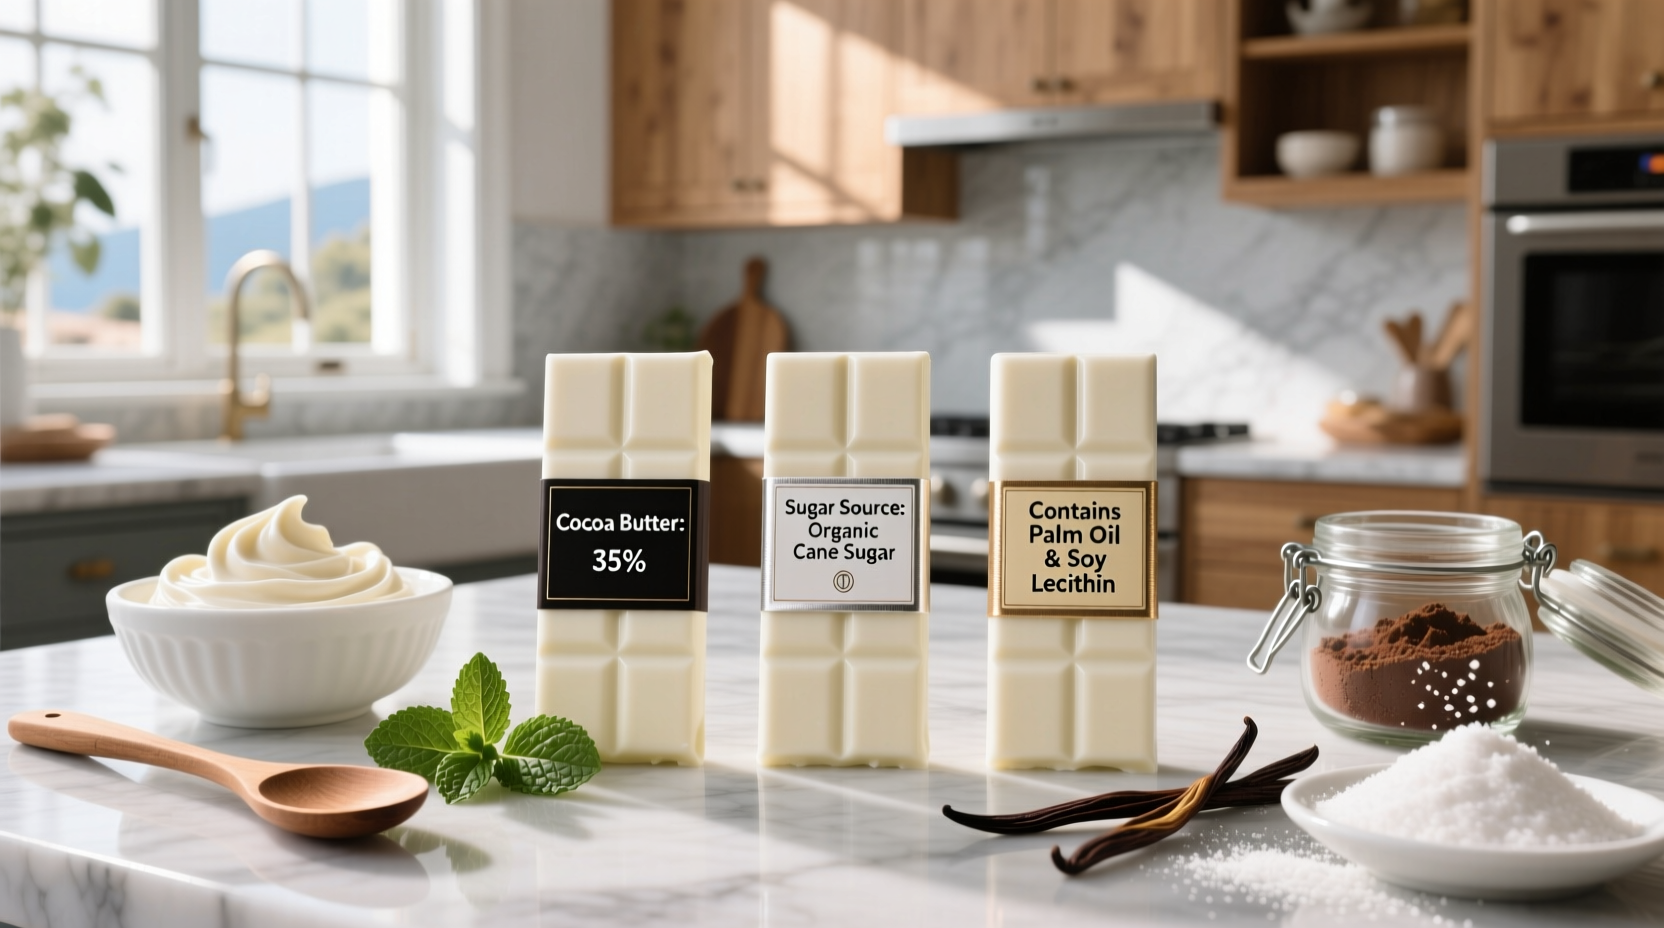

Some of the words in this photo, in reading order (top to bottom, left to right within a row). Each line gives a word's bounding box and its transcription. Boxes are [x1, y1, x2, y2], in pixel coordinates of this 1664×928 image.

[785, 499, 835, 520] Sugar
[839, 499, 906, 516] Source:
[1029, 501, 1122, 520] Contains
[556, 513, 615, 532] Cocoa
[619, 513, 685, 532] Butter:
[808, 521, 879, 543] Organic
[1029, 524, 1083, 544] Palm
[1089, 524, 1120, 545] Oil
[592, 548, 647, 573] 35%
[793, 543, 839, 560] Cane
[844, 543, 896, 565] Sugar
[1044, 548, 1061, 568] &
[1067, 548, 1107, 573] Soy
[1031, 573, 1116, 594] Lecithin
